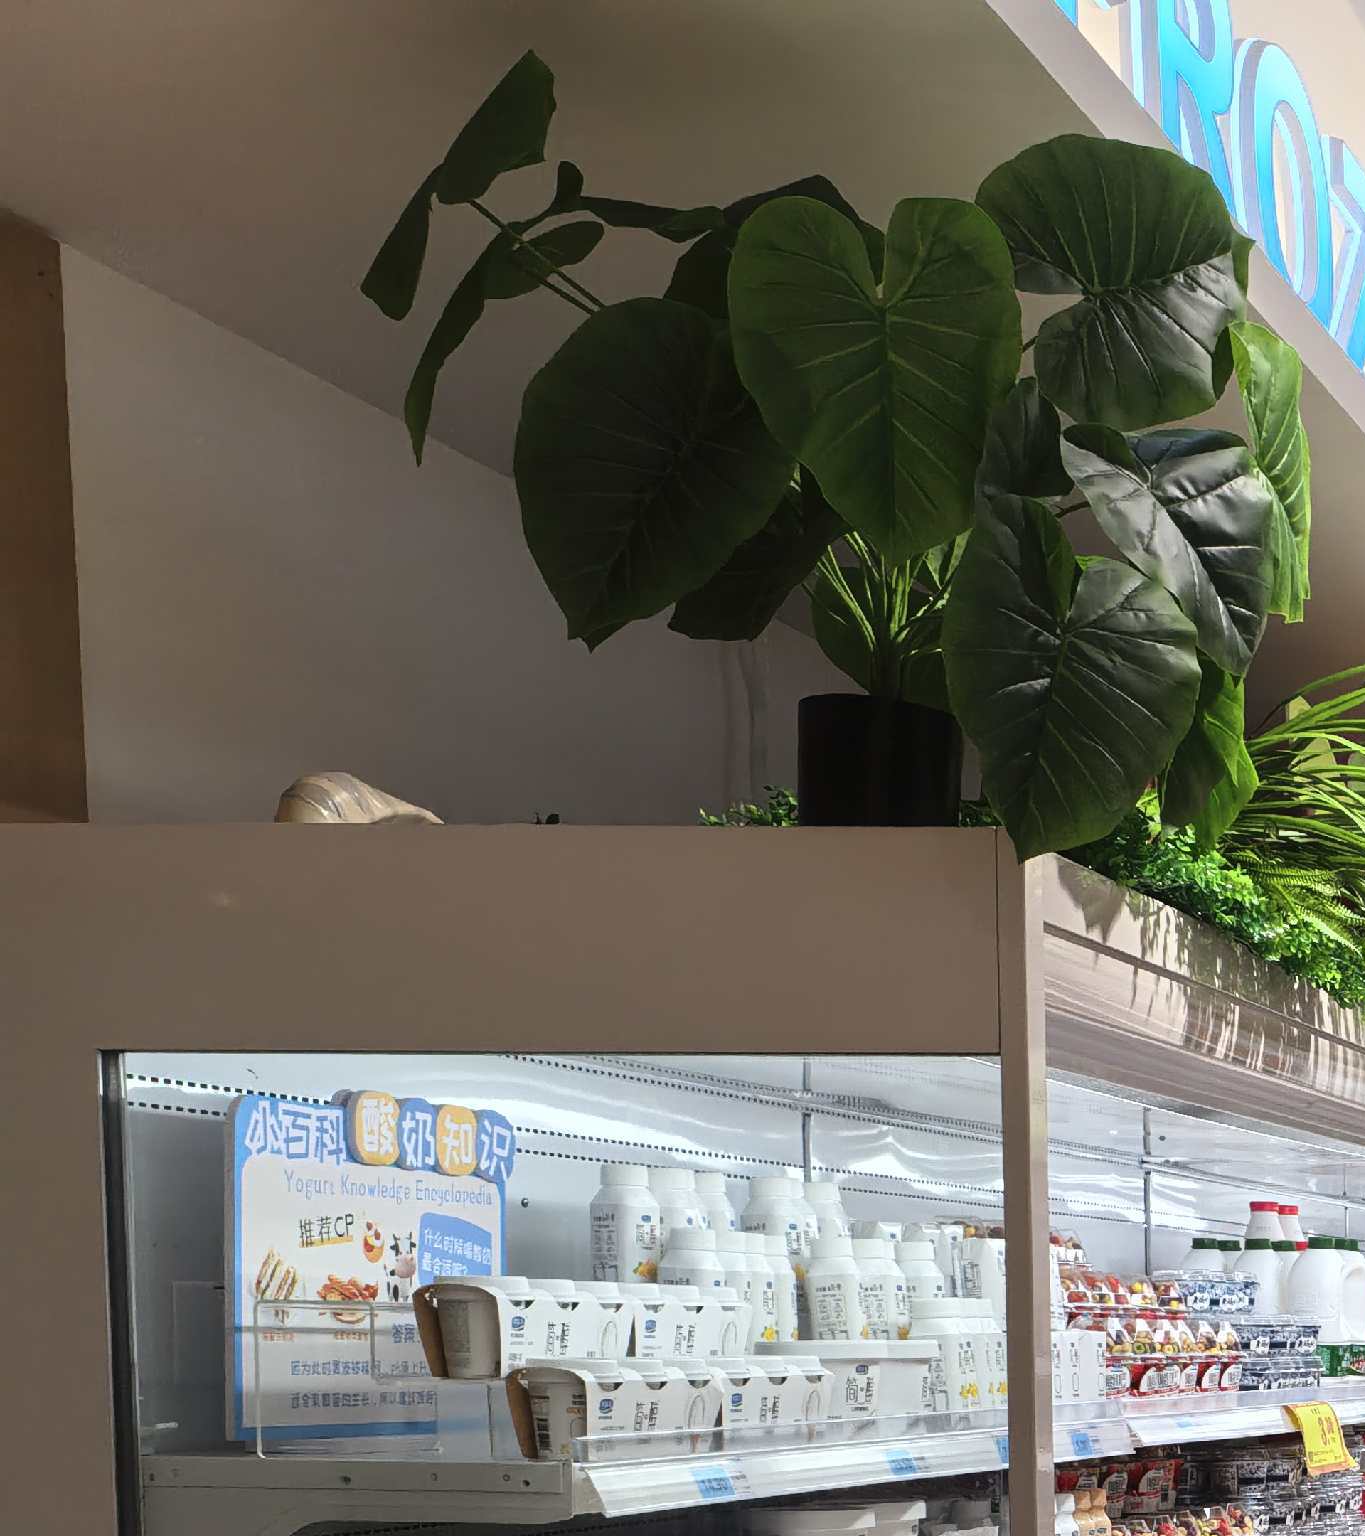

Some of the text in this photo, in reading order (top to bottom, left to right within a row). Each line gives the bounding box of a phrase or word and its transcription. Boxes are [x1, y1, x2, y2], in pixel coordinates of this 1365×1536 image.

[361, 1097, 513, 1183] 酸奶知识
[284, 1169, 493, 1207] Yogurt Knowledge Encyclopedia
[299, 1213, 355, 1247] 推荐CP
